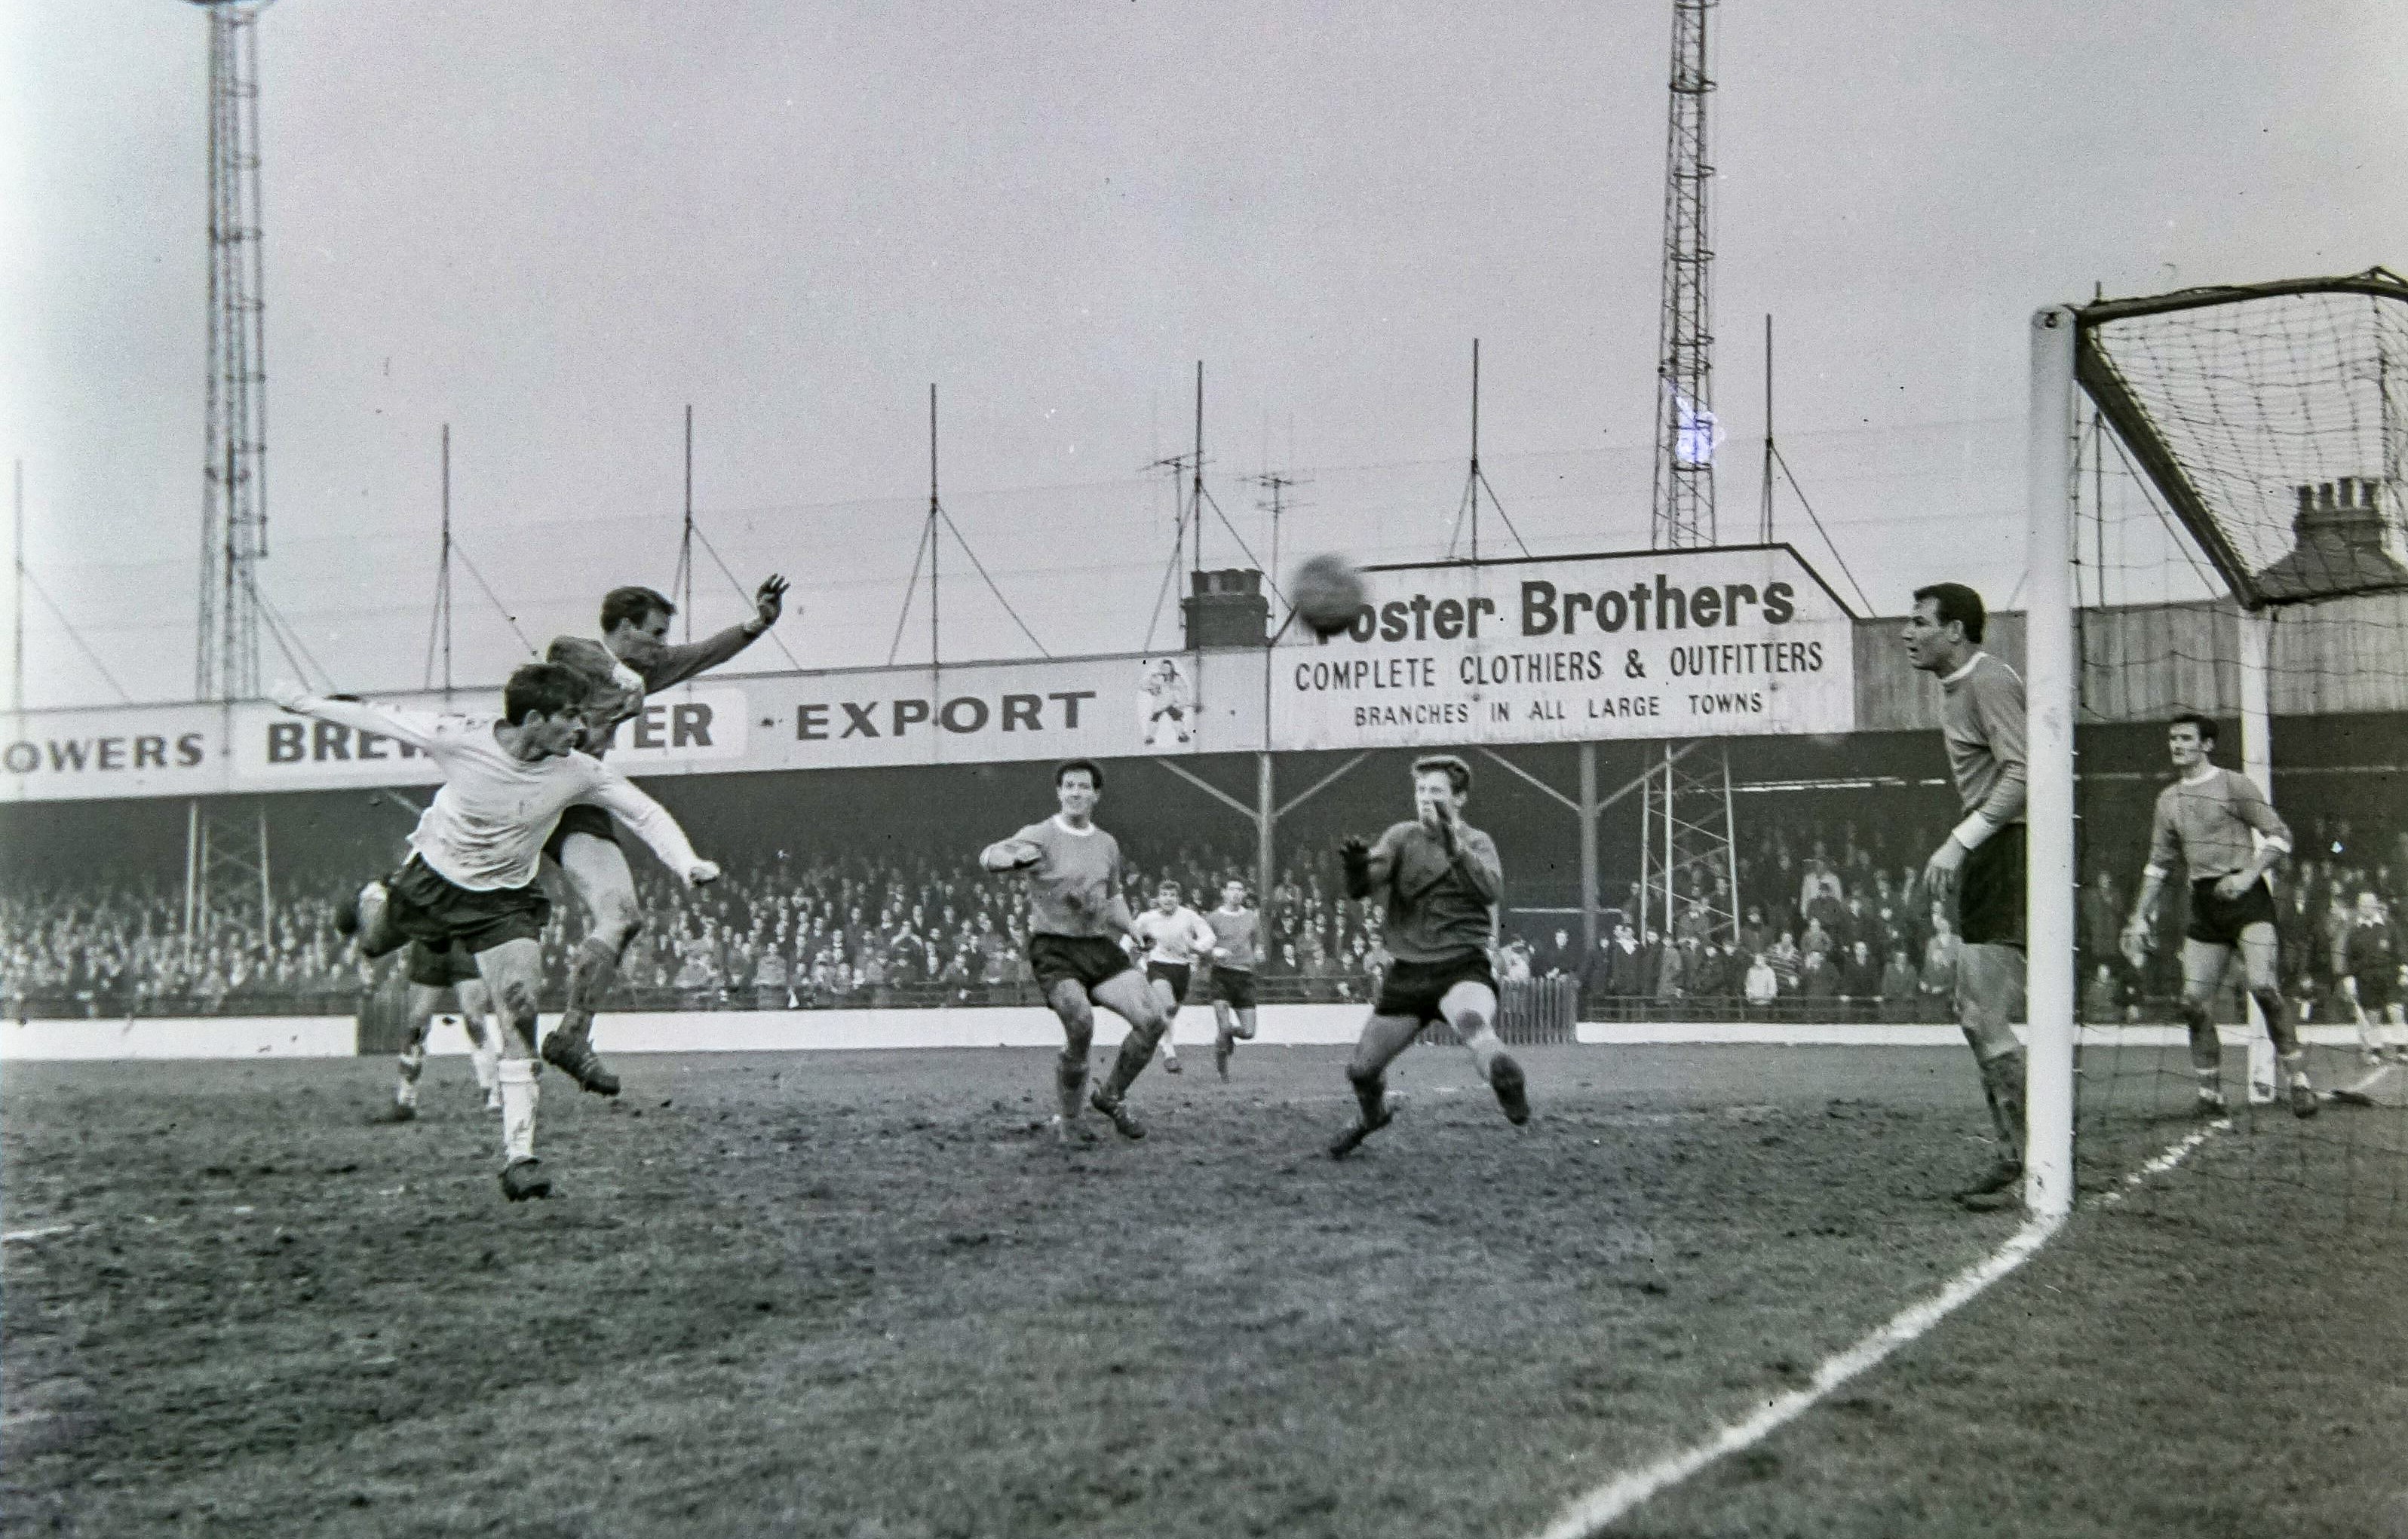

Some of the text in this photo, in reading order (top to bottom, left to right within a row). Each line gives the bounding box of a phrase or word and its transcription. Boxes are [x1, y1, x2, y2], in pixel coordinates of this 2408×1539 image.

[1315, 573, 1795, 645] oster Brothers
[1294, 641, 1824, 691] COMPLETE CLOTHIERS & OUTFITTERS
[2, 733, 204, 773] OWERS
[796, 690, 1097, 741] EXPORT
[1354, 691, 1763, 728] BRANCHES IN ALL LARGE TOWNS
